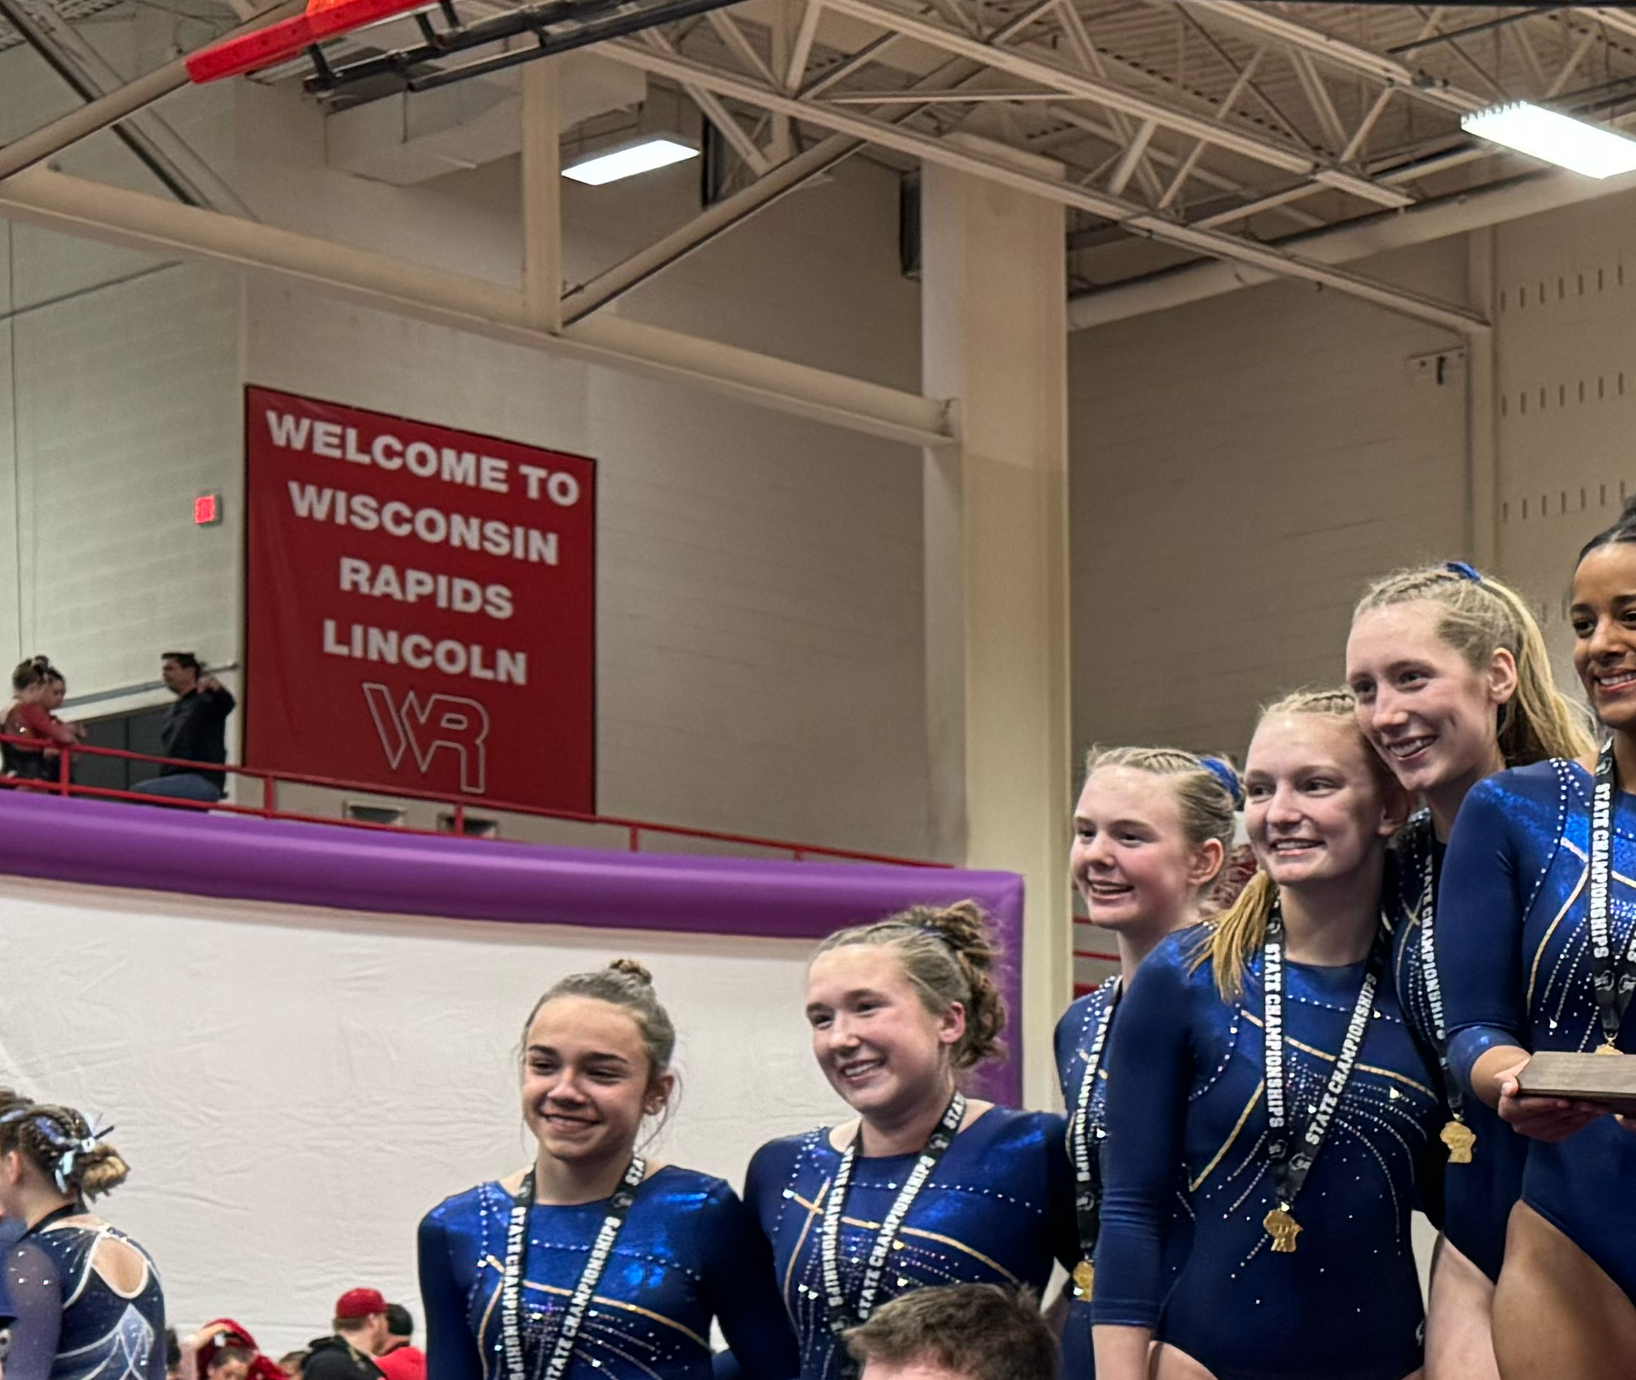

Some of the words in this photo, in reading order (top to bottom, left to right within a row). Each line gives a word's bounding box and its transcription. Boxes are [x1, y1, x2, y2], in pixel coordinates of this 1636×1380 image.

[266, 410, 509, 493] WELCOME
[519, 464, 580, 507] TO
[288, 481, 559, 566] WISCONSIN
[339, 556, 513, 620] RAPIDS
[323, 618, 527, 686] LINCOLN
[1592, 782, 1611, 829] STATE
[1589, 829, 1611, 959] CHAMPIONSHIPS
[1265, 942, 1282, 994] STATE
[1265, 994, 1286, 1129] CHAMPIONSHIPS
[1305, 1092, 1343, 1147] STATE
[1329, 972, 1378, 1095] CHAMPIONSHIPS
[506, 1206, 527, 1257] STATE
[868, 1155, 936, 1267] CHAMPIONSHIPS
[562, 1214, 622, 1338] CHAMPIONSHIPS
[858, 1269, 881, 1320] STATE
